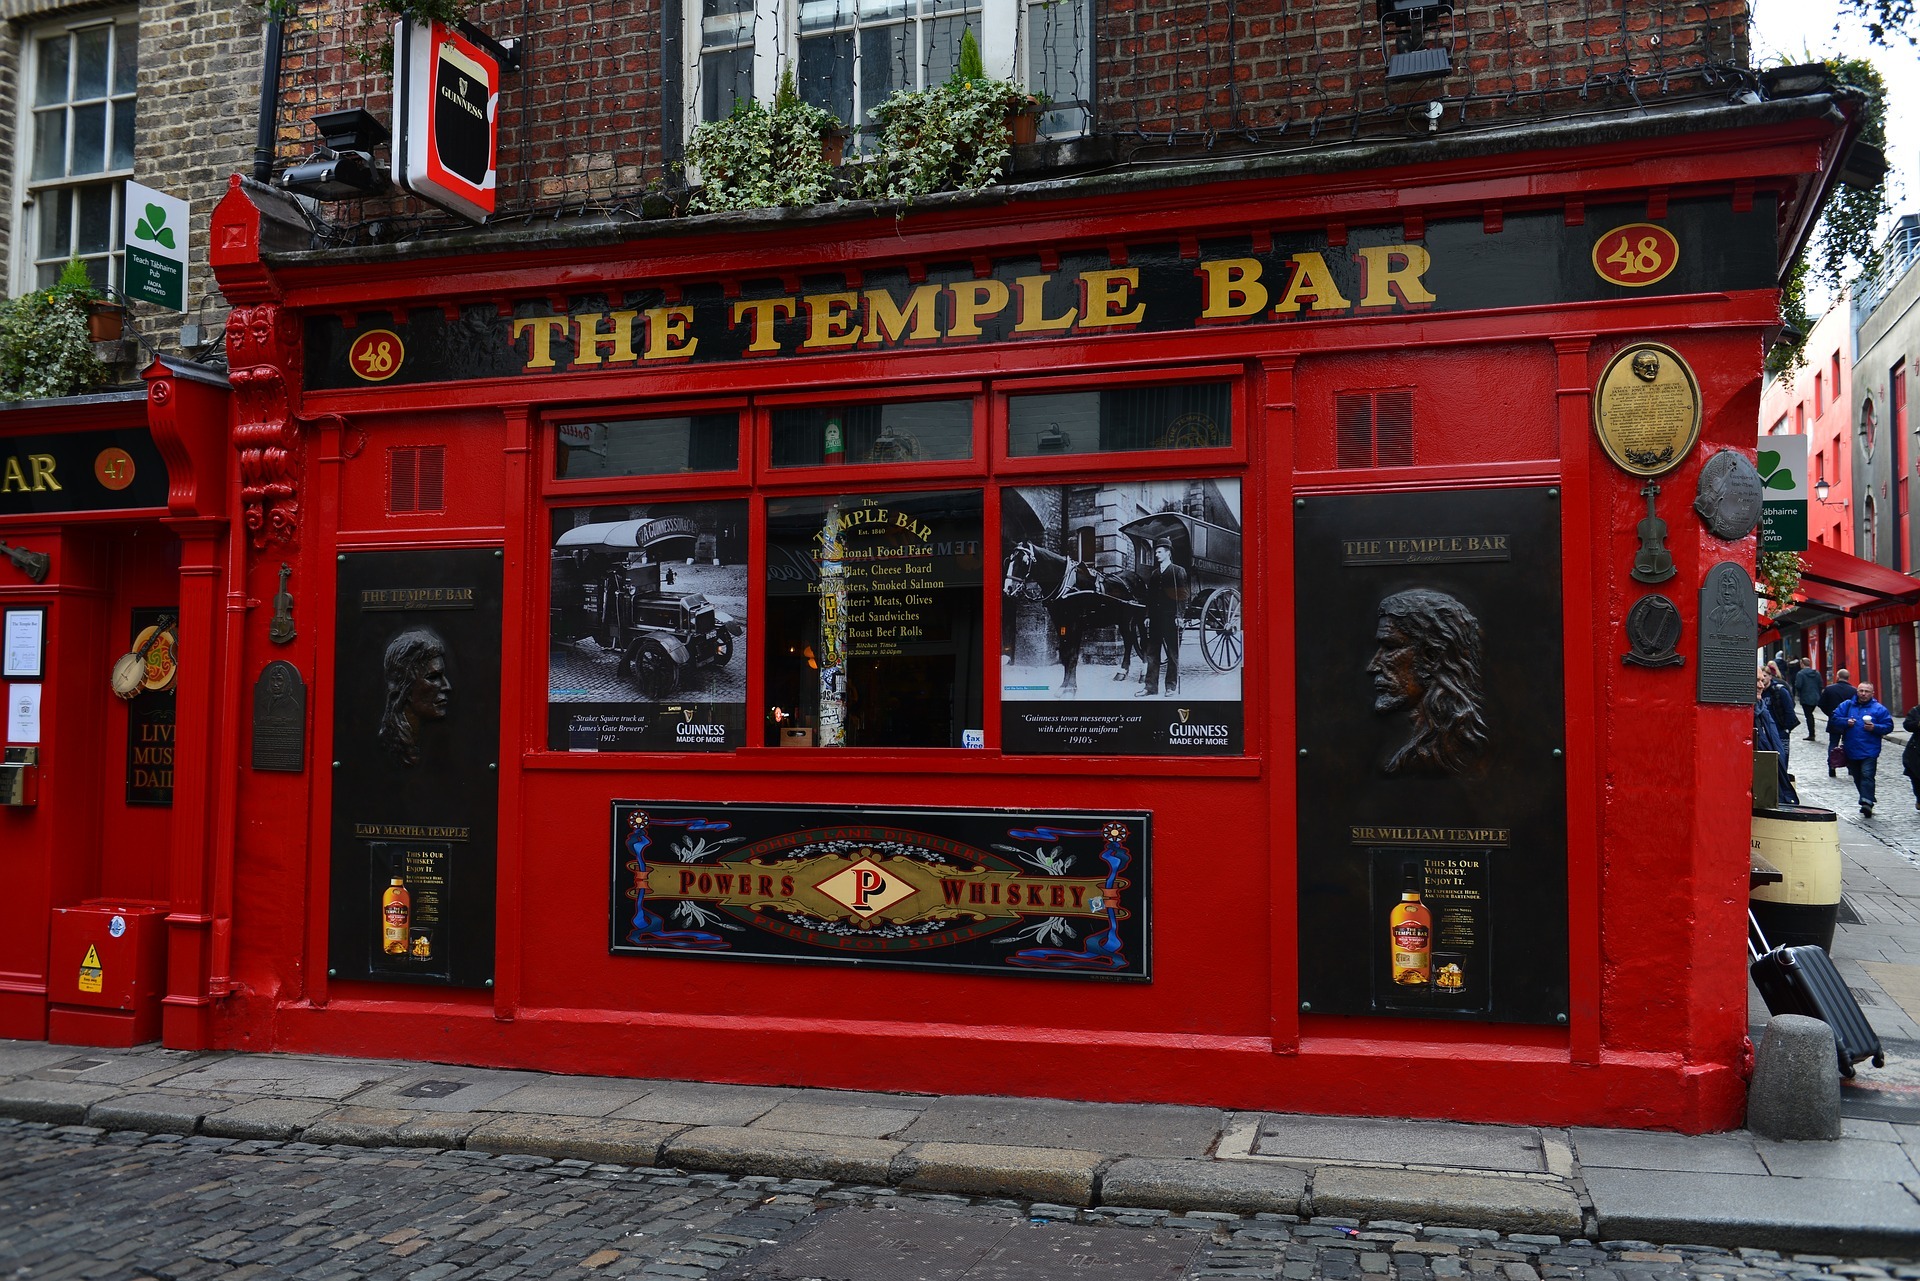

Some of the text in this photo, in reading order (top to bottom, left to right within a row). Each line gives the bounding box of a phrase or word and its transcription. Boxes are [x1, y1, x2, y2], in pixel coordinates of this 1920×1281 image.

[441, 85, 483, 120] GUINNESS
[132, 253, 149, 266] Teach
[1606, 236, 1662, 276] 48
[149, 268, 161, 279] Pub
[143, 285, 166, 296] APPROVED
[511, 244, 1437, 370] THE TEMPLE BAR
[358, 341, 393, 373] 48
[104, 458, 126, 480] 47
[861, 498, 879, 507] The
[1763, 508, 1798, 516] ábhairne
[895, 512, 933, 543] BAR
[811, 545, 933, 560] Trional Food Fare
[1343, 536, 1507, 555] THE TEMPLE BAR
[843, 565, 868, 578] Plate,
[871, 565, 902, 575] Cheese
[905, 563, 932, 574] Board
[833, 581, 869, 593] sters,
[872, 580, 907, 591] Smoked
[910, 579, 944, 589] Salmon
[361, 588, 473, 603] THE TEMPLE BAR
[873, 595, 902, 607] Meats,
[905, 595, 933, 605] Olives
[868, 611, 920, 622] Sandwiches
[848, 627, 873, 638] Roast
[876, 627, 897, 638] Beef
[900, 626, 923, 636] Rolls
[600, 714, 620, 723] Squire
[1125, 714, 1142, 722] cart
[676, 722, 725, 735] GUINNESS
[1038, 725, 1055, 733] with
[1055, 725, 1078, 733] driver
[1080, 725, 1088, 733] in
[1169, 722, 1229, 737] GUINNESS
[966, 733, 981, 742] tax
[1205, 738, 1229, 746] MORE
[133, 747, 175, 765] MUS
[134, 770, 175, 787] DAIL
[356, 824, 468, 838] LADY MARTHA TEMPLE
[1352, 827, 1508, 842] SIR WILLIAM TEMPLE
[823, 826, 874, 840] LANE
[882, 828, 988, 864] DISTILLERY
[1459, 860, 1479, 868] OUR
[678, 868, 1086, 911] POWERS P WHISKEY
[752, 914, 982, 949] PURE POT STILL
